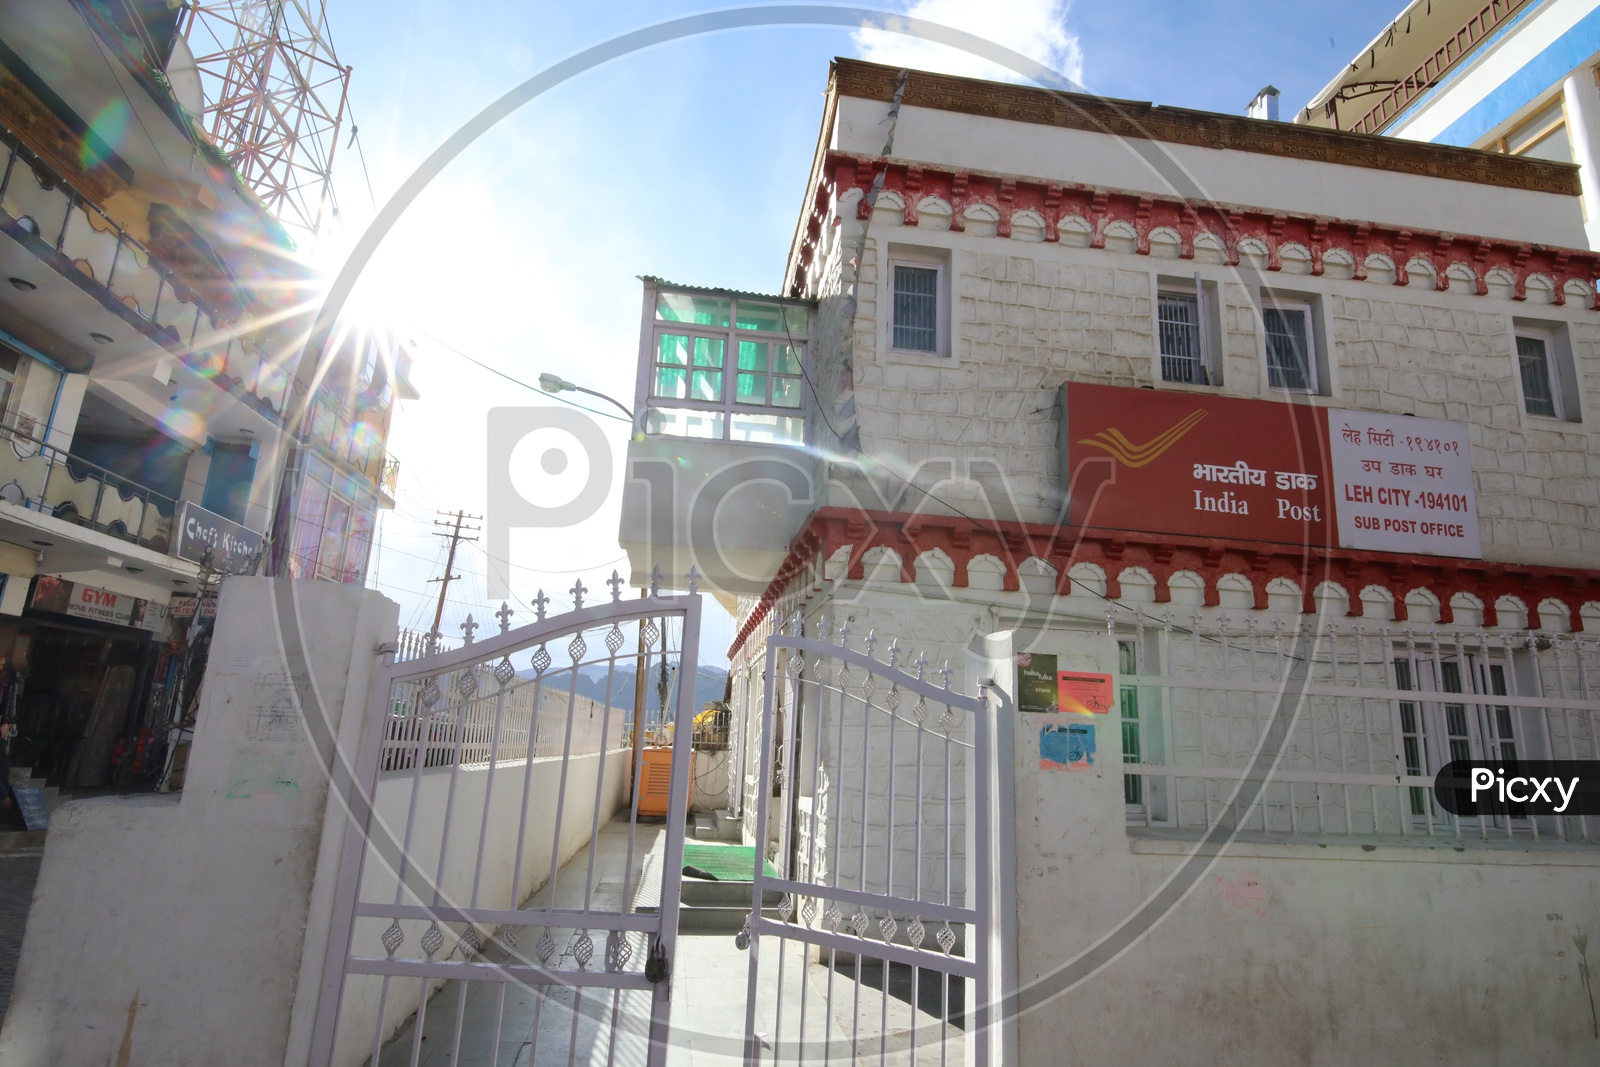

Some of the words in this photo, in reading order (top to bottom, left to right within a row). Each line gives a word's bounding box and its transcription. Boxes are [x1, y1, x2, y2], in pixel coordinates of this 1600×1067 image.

[1341, 422, 1361, 446] लेह
[1367, 427, 1394, 447] सिटी
[1193, 460, 1266, 486] भारतीय
[1274, 471, 1318, 490] डाक
[1361, 459, 1381, 473] उप
[1389, 462, 1416, 476] डाक
[1424, 466, 1443, 479] घर
[1193, 489, 1249, 515] India
[1276, 498, 1321, 522] Post
[1345, 484, 1373, 503] LEH
[1378, 487, 1410, 507] CITY
[186, 517, 218, 549] Chef's
[222, 532, 254, 556] Kitche
[1354, 516, 1380, 530] SUB
[1384, 518, 1416, 533] POST
[1421, 522, 1464, 537] OFFICE
[81, 587, 117, 608] GYM
[69, 603, 86, 612] NOVA
[88, 606, 114, 617] FITNESS
[115, 612, 131, 621] CLUB
